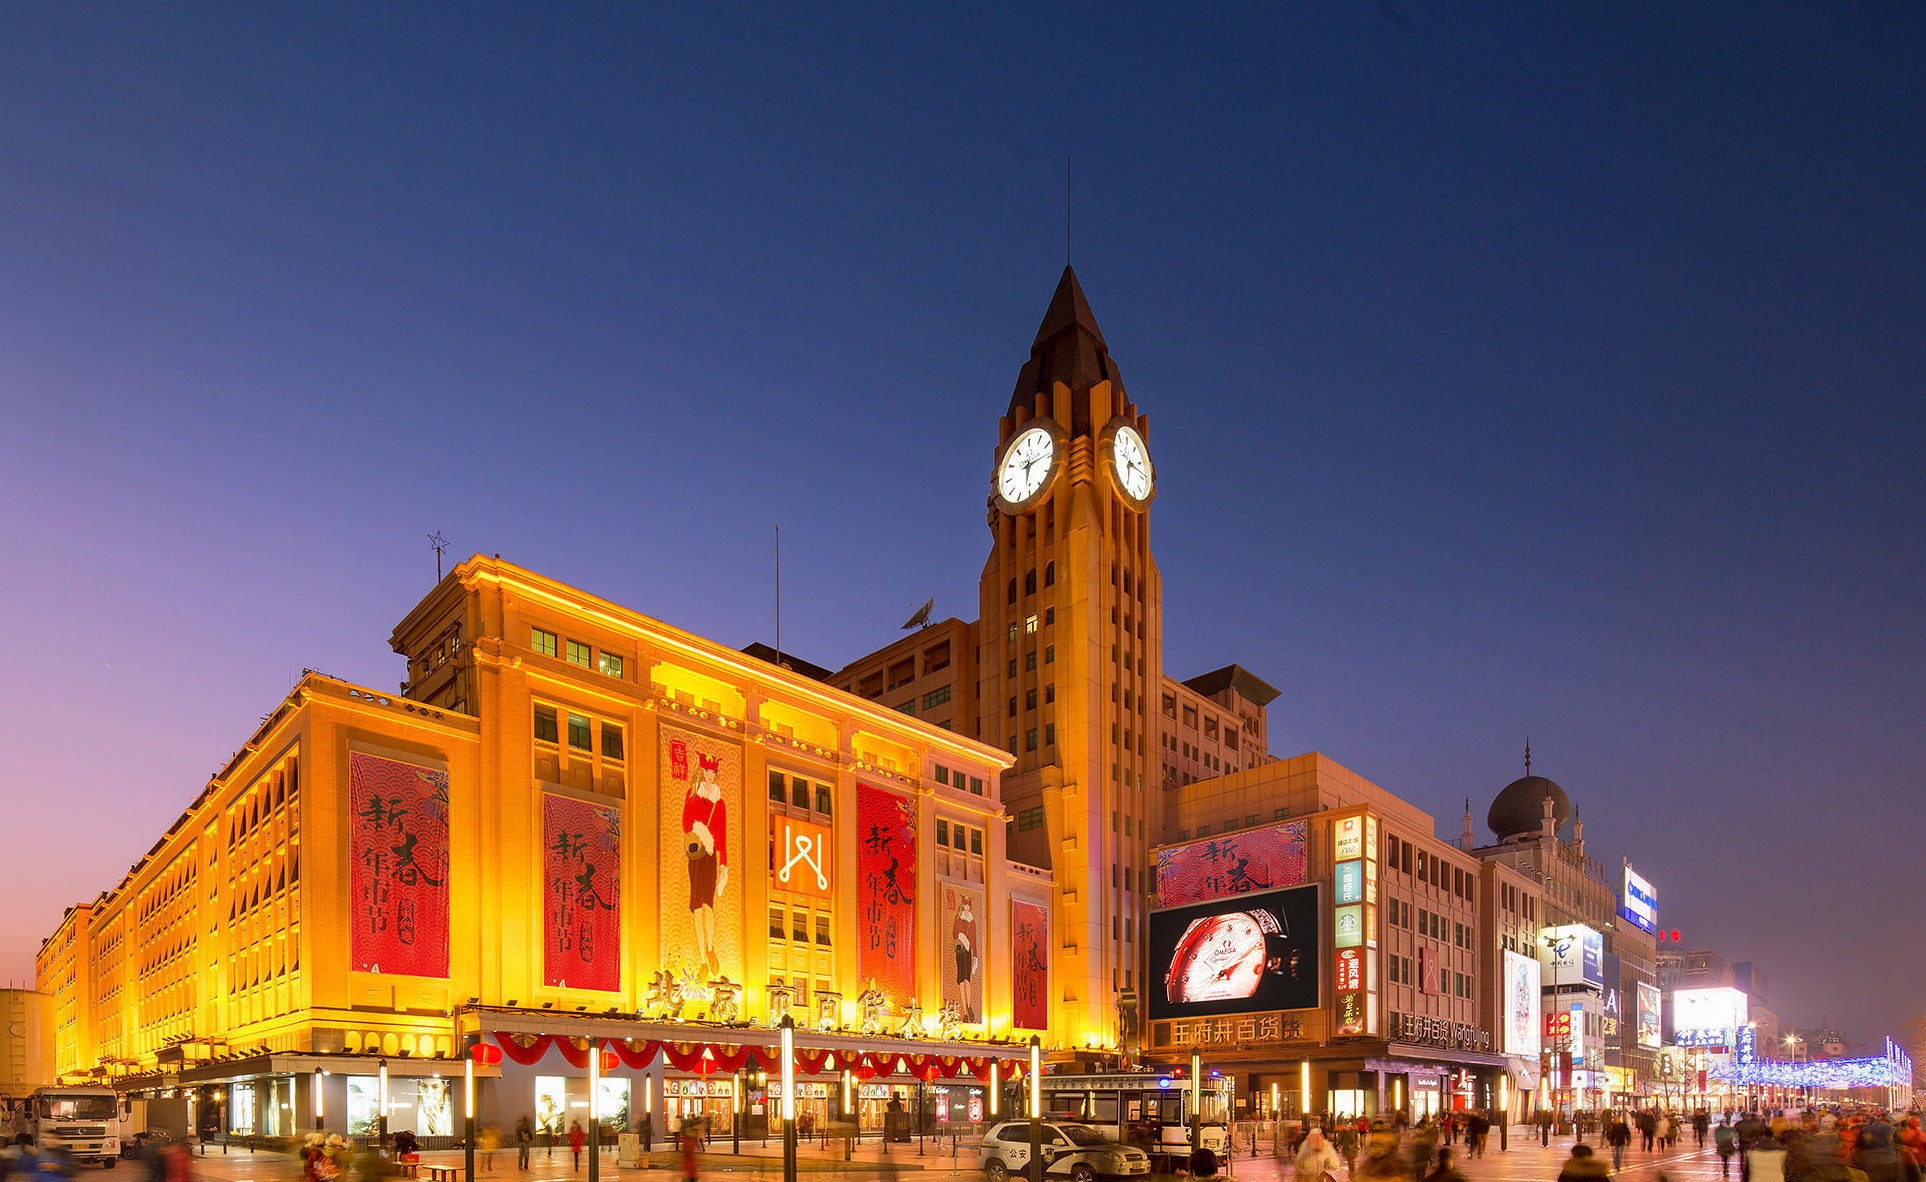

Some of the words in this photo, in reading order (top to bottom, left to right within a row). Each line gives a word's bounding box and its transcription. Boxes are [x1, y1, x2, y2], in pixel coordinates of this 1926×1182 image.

[359, 794, 444, 887] 新春
[864, 823, 913, 906] 新春
[1200, 838, 1274, 893] 新春
[360, 848, 390, 934] 年市节
[550, 829, 616, 911] 新春
[551, 877, 575, 953] 年市节
[1015, 922, 1048, 972] 新春
[1214, 947, 1237, 957] OMEGA
[1173, 1016, 1280, 1045] 王府井百货
[1405, 1014, 1448, 1042] 王府井百货
[1449, 1021, 1490, 1049] Wangfujing
[1009, 1148, 1027, 1159] 公安
